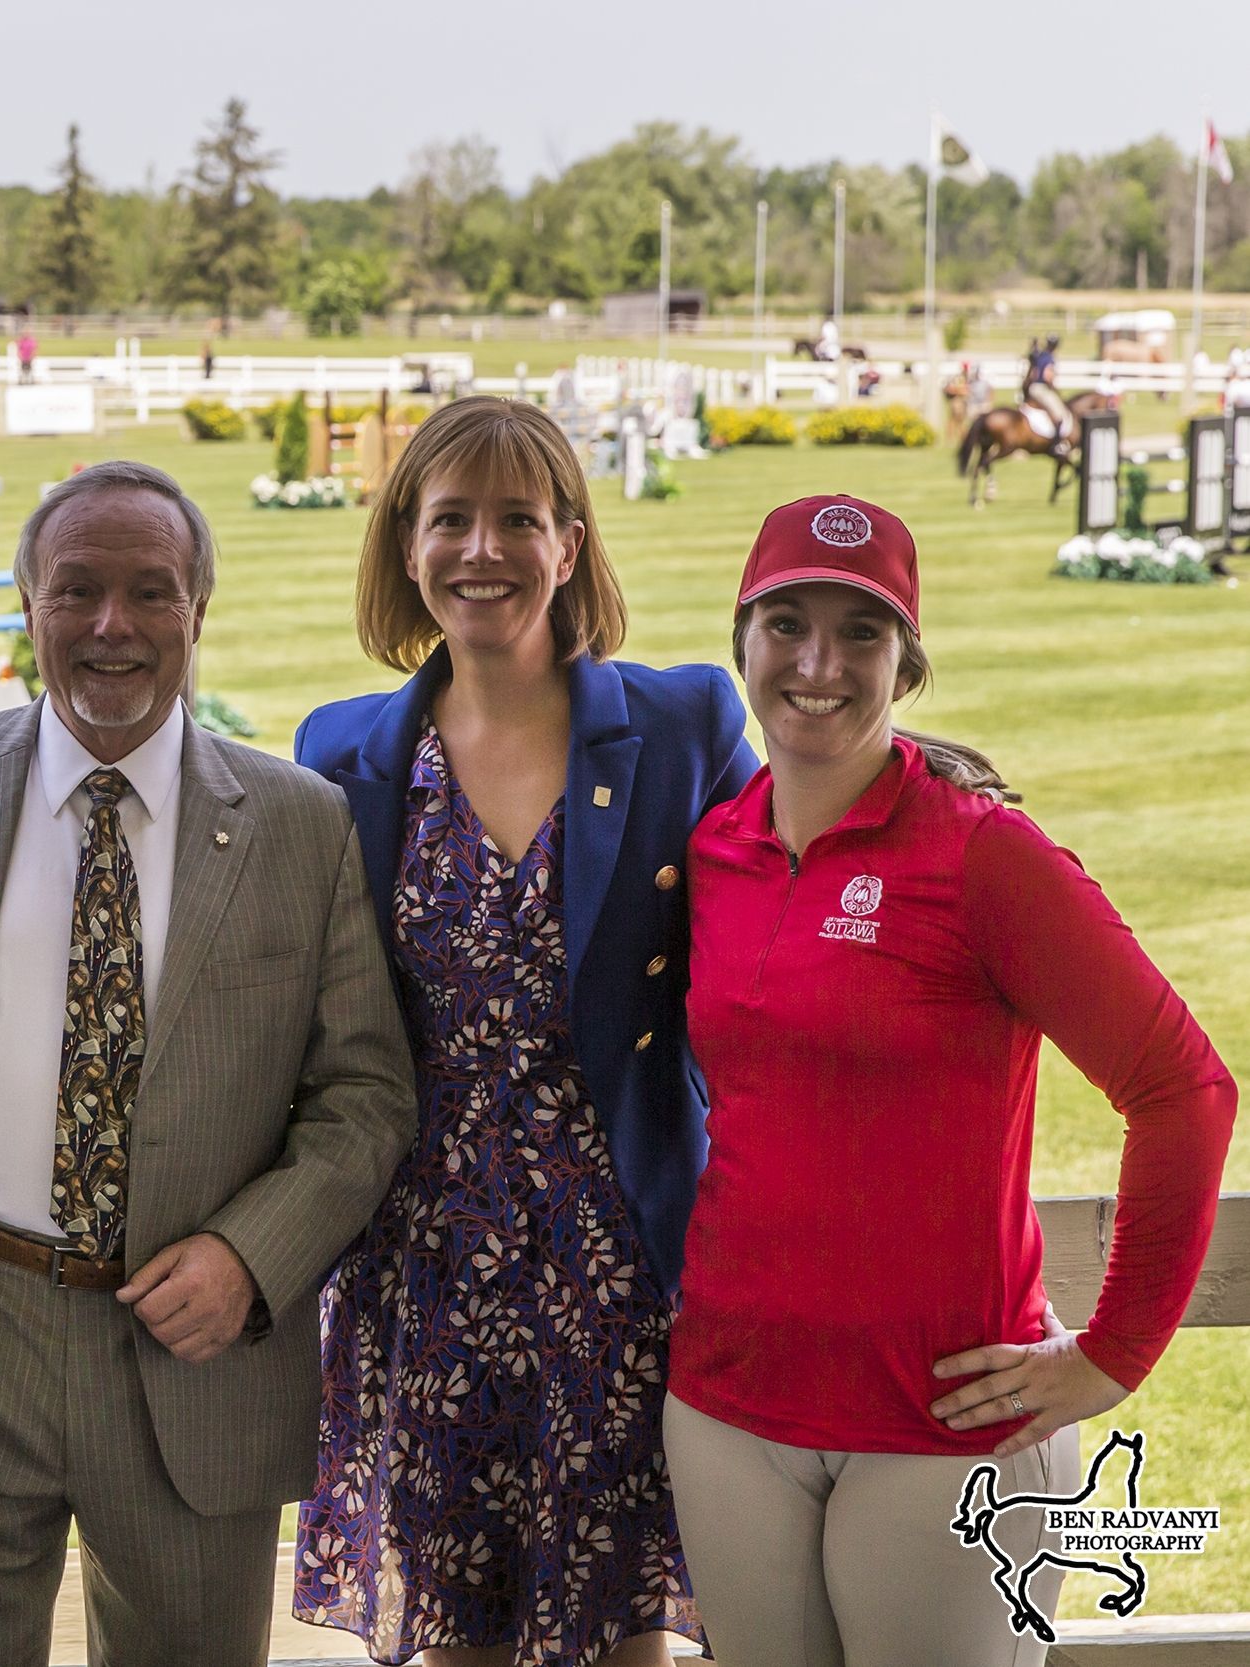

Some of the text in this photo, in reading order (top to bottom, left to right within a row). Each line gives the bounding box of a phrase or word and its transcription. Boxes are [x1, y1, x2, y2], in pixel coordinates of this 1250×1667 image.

[826, 509, 862, 521] WESLEY
[823, 530, 860, 542] CLOVER
[826, 922, 876, 939] OTTAWA
